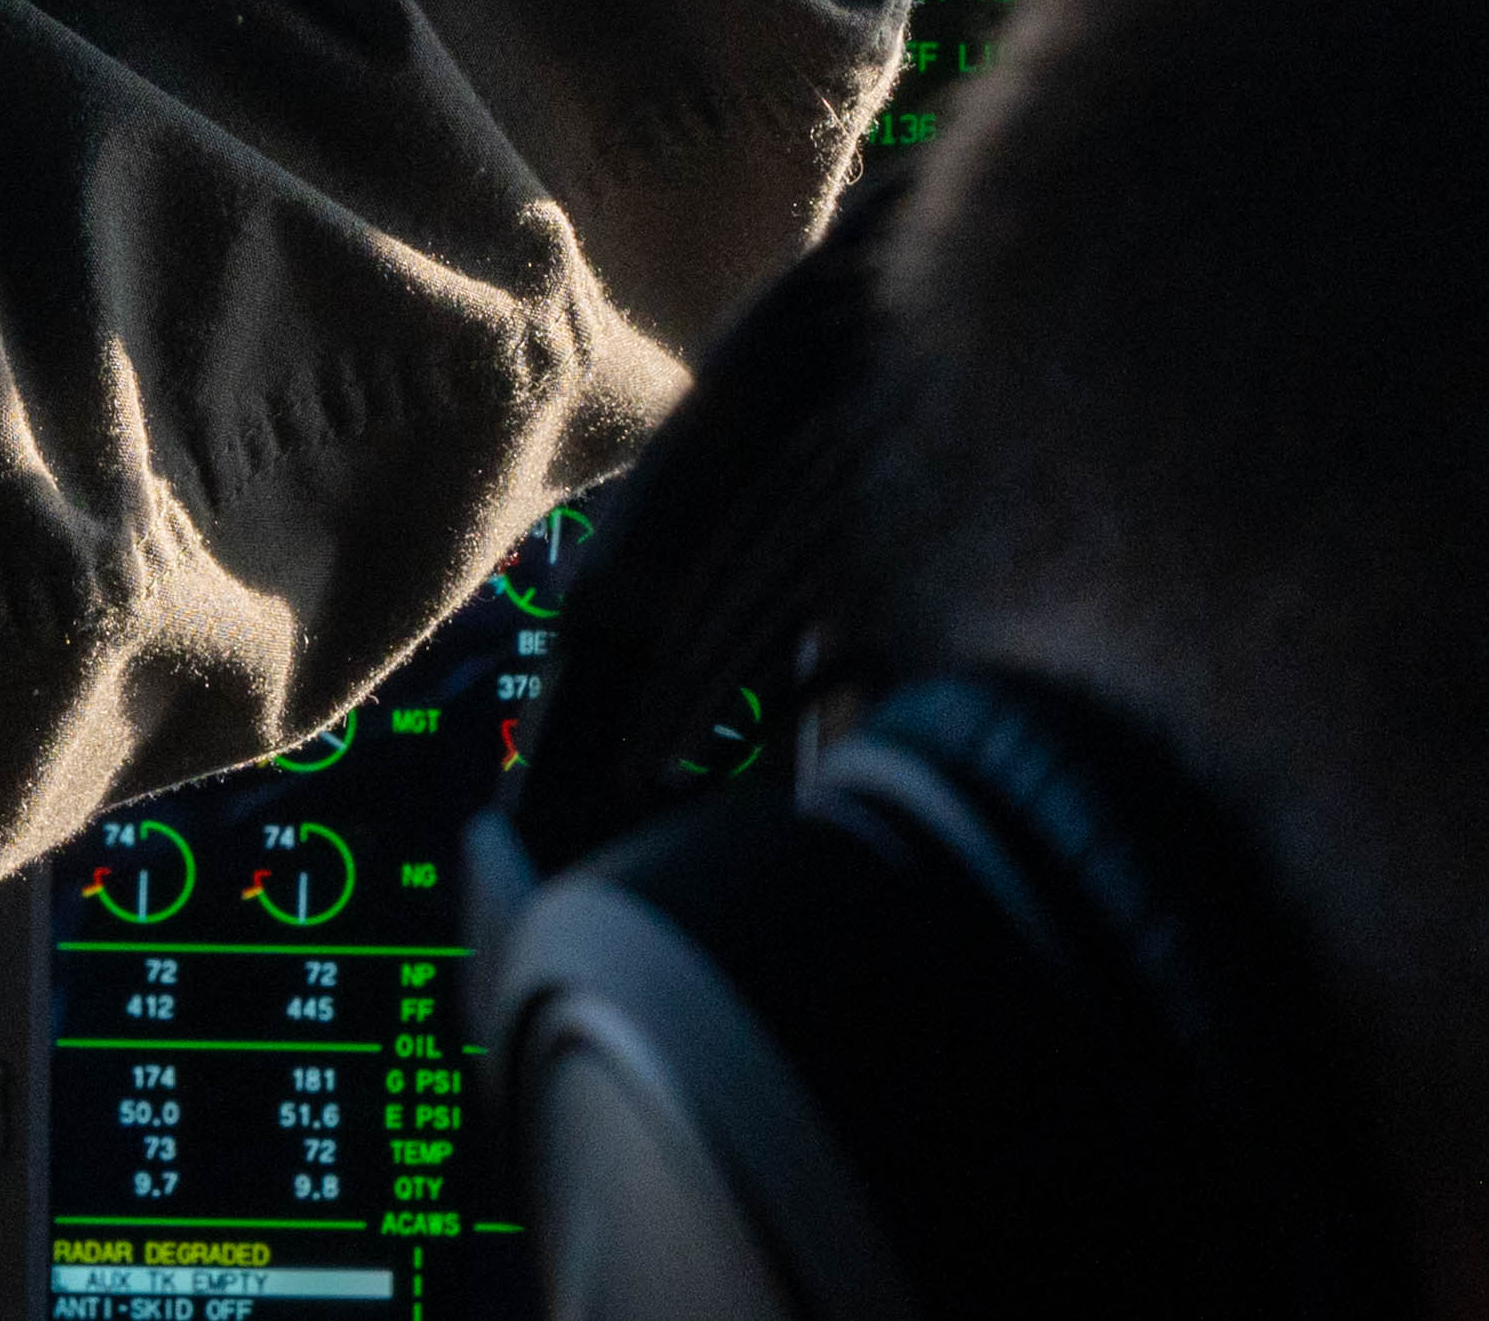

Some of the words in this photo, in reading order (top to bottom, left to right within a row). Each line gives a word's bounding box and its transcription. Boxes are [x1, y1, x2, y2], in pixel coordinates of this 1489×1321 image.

[392, 708, 442, 736] MGT
[104, 823, 135, 848] 74
[263, 824, 296, 850] 74
[399, 863, 439, 889] NG
[144, 960, 178, 986] 72
[304, 961, 338, 987] 72
[399, 962, 437, 989] NP
[125, 995, 176, 1021] 412
[285, 997, 335, 1023] 445
[399, 997, 436, 1023] FF
[394, 1034, 442, 1060] OIL
[131, 1066, 178, 1091] 174
[292, 1068, 337, 1093] 181
[384, 1068, 406, 1095] G
[415, 1069, 463, 1095] PSI
[118, 1101, 181, 1128] 50.0
[278, 1103, 341, 1130] 51.6
[384, 1104, 405, 1131] E
[415, 1105, 463, 1131] PSI
[143, 1136, 178, 1162] 73
[303, 1139, 337, 1165] 72
[388, 1139, 454, 1165] TEMP
[133, 1171, 181, 1198] 9.7
[293, 1174, 341, 1201] 9.8
[393, 1175, 444, 1202] QTY
[380, 1210, 462, 1238] ACAWS
[52, 1239, 134, 1264] RADAR
[144, 1241, 271, 1267] DEGRADED
[86, 1269, 131, 1292] AUX
[192, 1271, 270, 1293] EMPTY
[52, 1296, 194, 1321] ANTI-SKID
[206, 1298, 255, 1321] OFF
